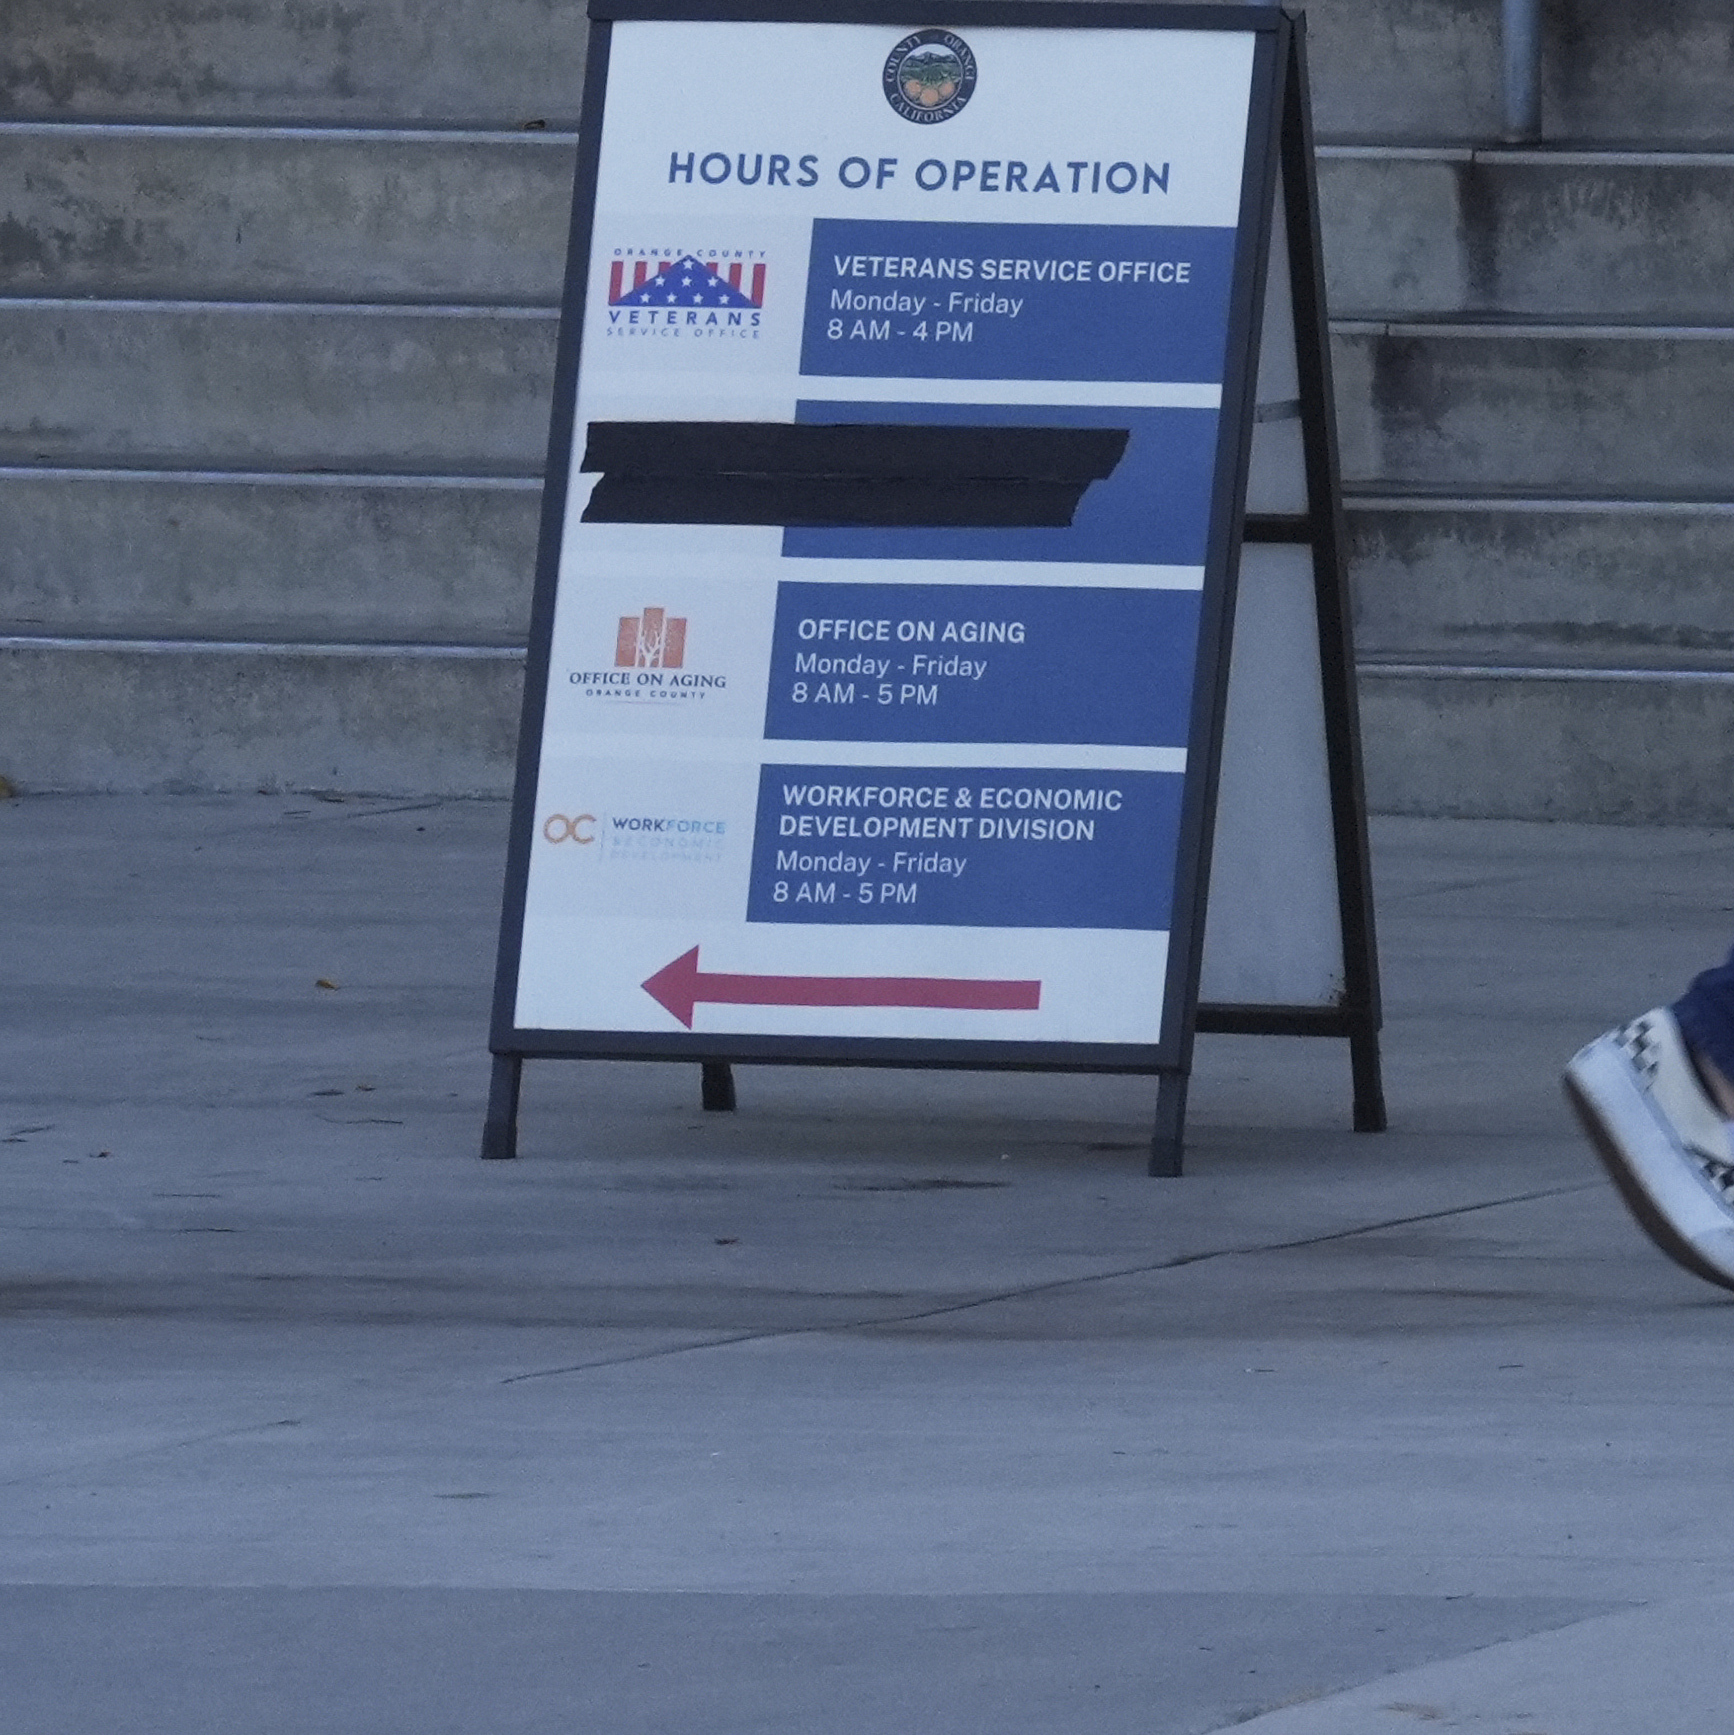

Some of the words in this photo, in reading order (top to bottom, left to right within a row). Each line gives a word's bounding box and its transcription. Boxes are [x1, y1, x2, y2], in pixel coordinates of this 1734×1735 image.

[889, 93, 967, 122] CALIFORNIA
[668, 151, 819, 188] HOURS
[838, 156, 898, 190] OF
[915, 158, 1170, 195] OPERATION
[613, 248, 682, 257] ORANGE
[696, 249, 766, 258] COUNTY
[834, 255, 974, 280] VETERANS
[980, 258, 1092, 282] SERVICE
[1098, 261, 1191, 283] OFFICE
[830, 288, 927, 316] Monday
[948, 291, 1024, 318] Friday
[609, 310, 761, 326] VETERANS
[827, 318, 843, 340] 8
[849, 319, 891, 340] AM
[912, 320, 928, 341] 4
[935, 321, 974, 342] PM
[607, 327, 680, 336] SERVICE
[694, 328, 759, 339] OFFICE
[798, 618, 891, 641] OFFICE
[896, 620, 935, 642] ON
[941, 621, 1025, 644] AGING
[795, 652, 891, 679] Monday
[912, 654, 987, 681] Friday
[569, 672, 627, 685] OFFICE
[636, 673, 664, 686] ON
[669, 674, 726, 688] AGING
[791, 681, 808, 703] 8
[814, 682, 855, 704] AM
[877, 683, 893, 705] 5
[900, 683, 938, 705] PM
[585, 688, 640, 698] ORANGE
[649, 690, 706, 700] COUNTY
[783, 784, 949, 808] WORKFORCE
[954, 787, 972, 809] &
[979, 787, 1123, 811] ECONOMIC
[543, 814, 597, 844] OC
[613, 817, 726, 834] WORKFORCE
[779, 814, 974, 838] DEVELOPMENT
[979, 817, 1095, 841] DIVISION
[776, 849, 871, 877] Monday
[892, 851, 967, 878] Friday
[772, 880, 789, 903] 8
[795, 881, 836, 903] AM
[858, 882, 874, 904] 5
[880, 882, 917, 904] PM
